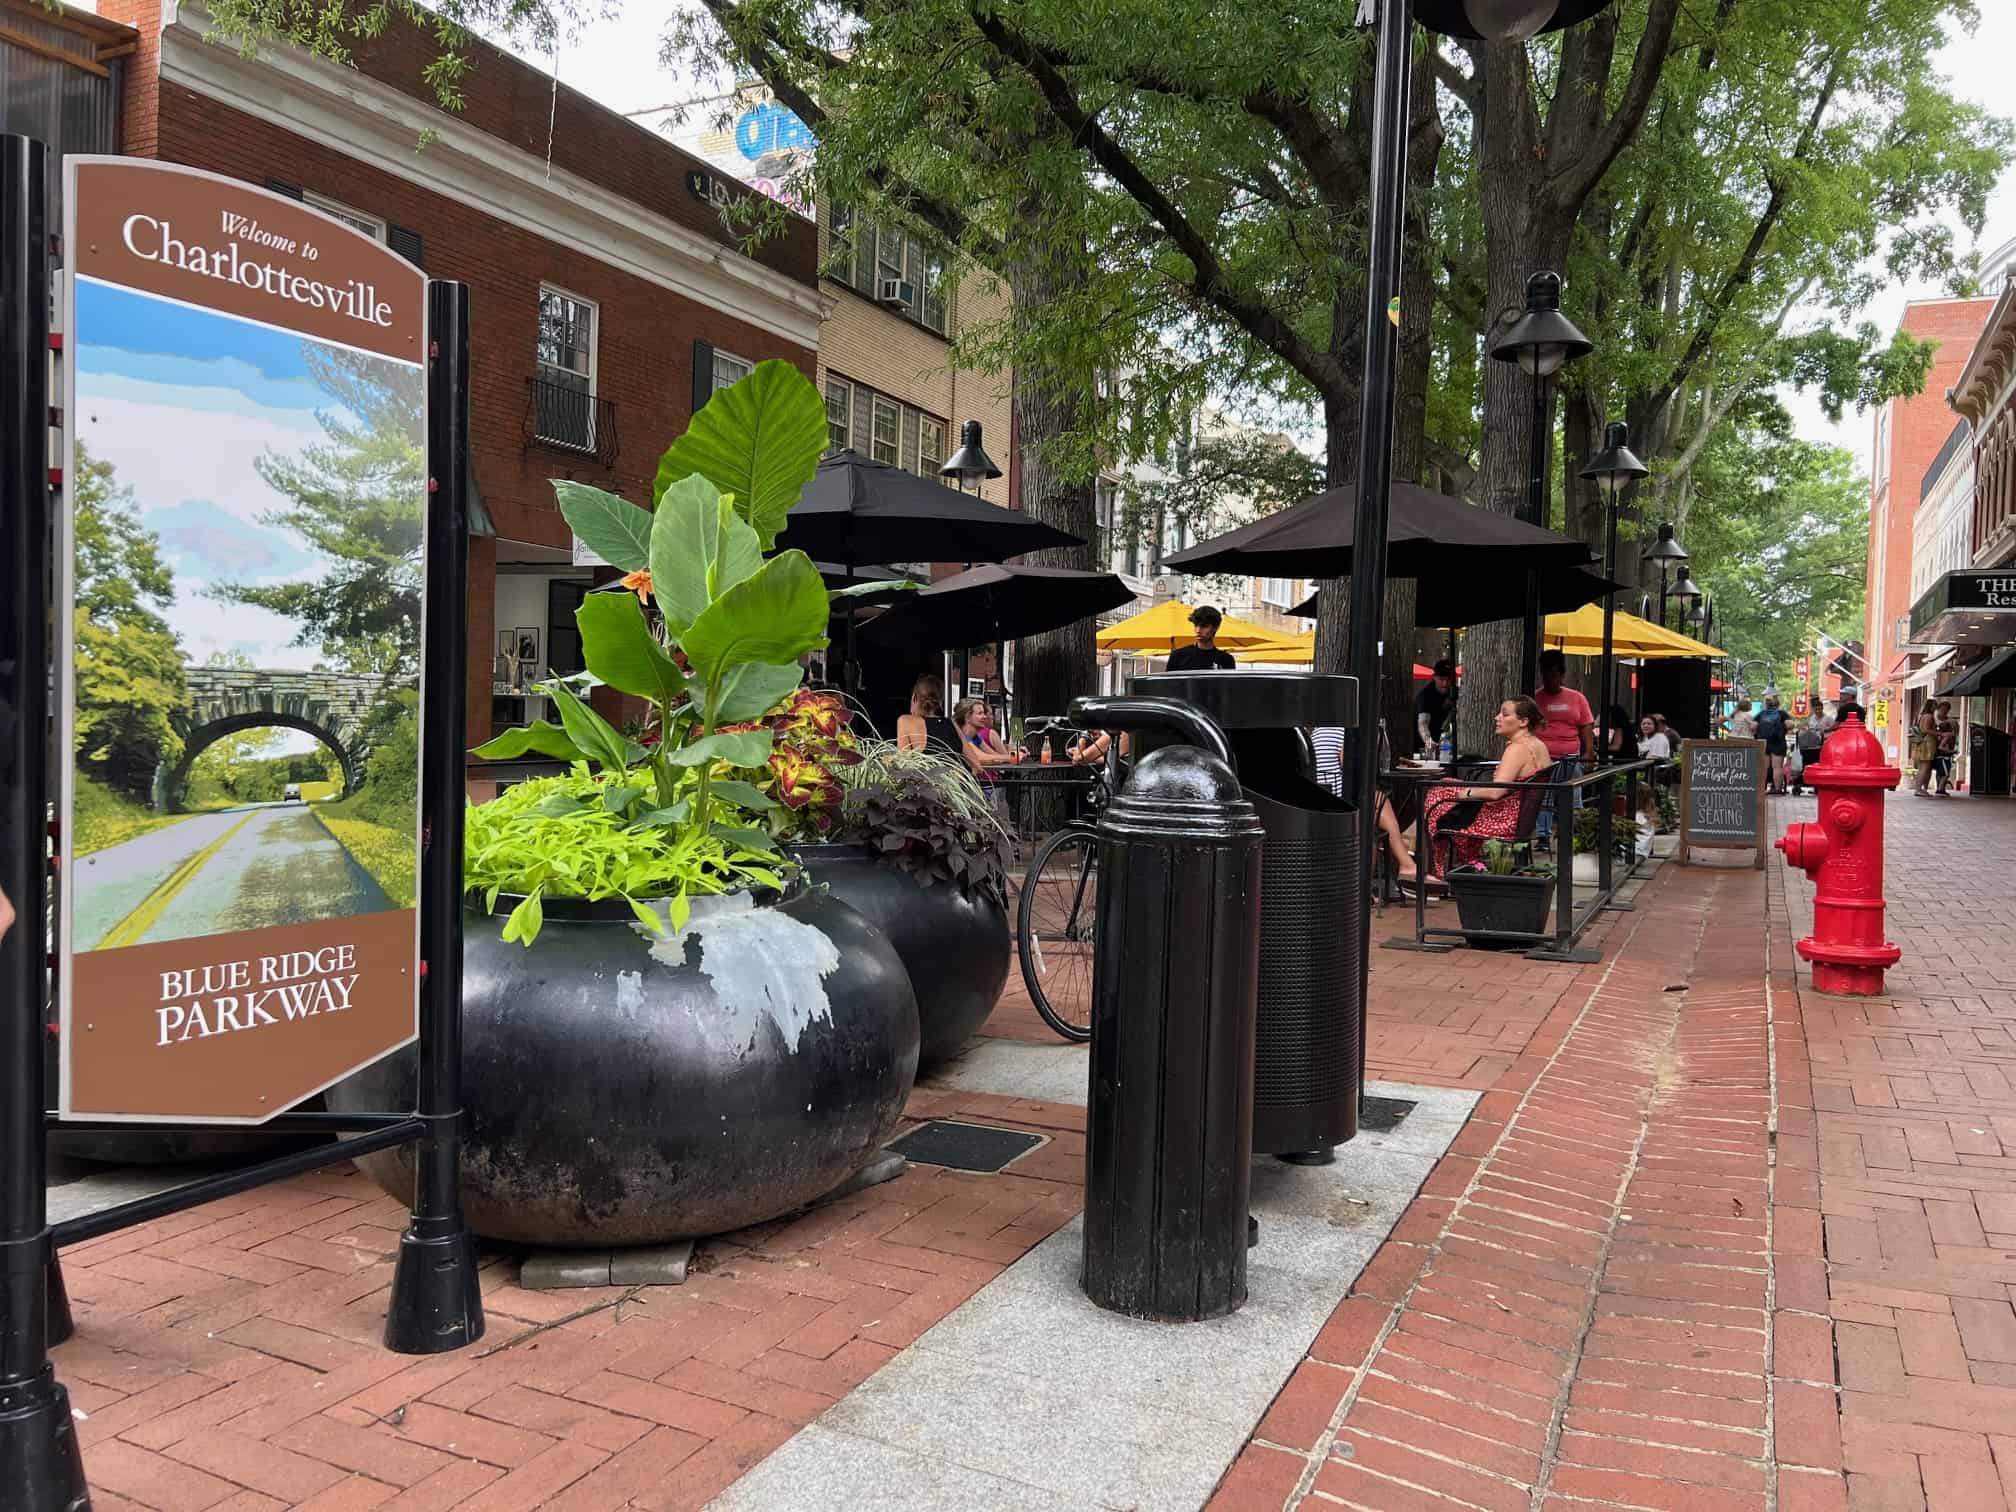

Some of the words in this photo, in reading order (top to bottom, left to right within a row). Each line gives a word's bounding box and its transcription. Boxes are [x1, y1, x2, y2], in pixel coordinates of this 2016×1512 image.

[221, 210, 296, 253] Welcome
[301, 241, 319, 261] to
[122, 213, 393, 327] Charlottesville
[1976, 578, 2016, 592] THE
[1692, 748, 1749, 769] botanical
[1697, 793, 1743, 809] OUTDOOR
[1697, 808, 1743, 827] SEATING
[160, 961, 250, 1001] BLUE
[259, 944, 357, 984] RIDGE
[155, 973, 361, 1046] PARKWAY
